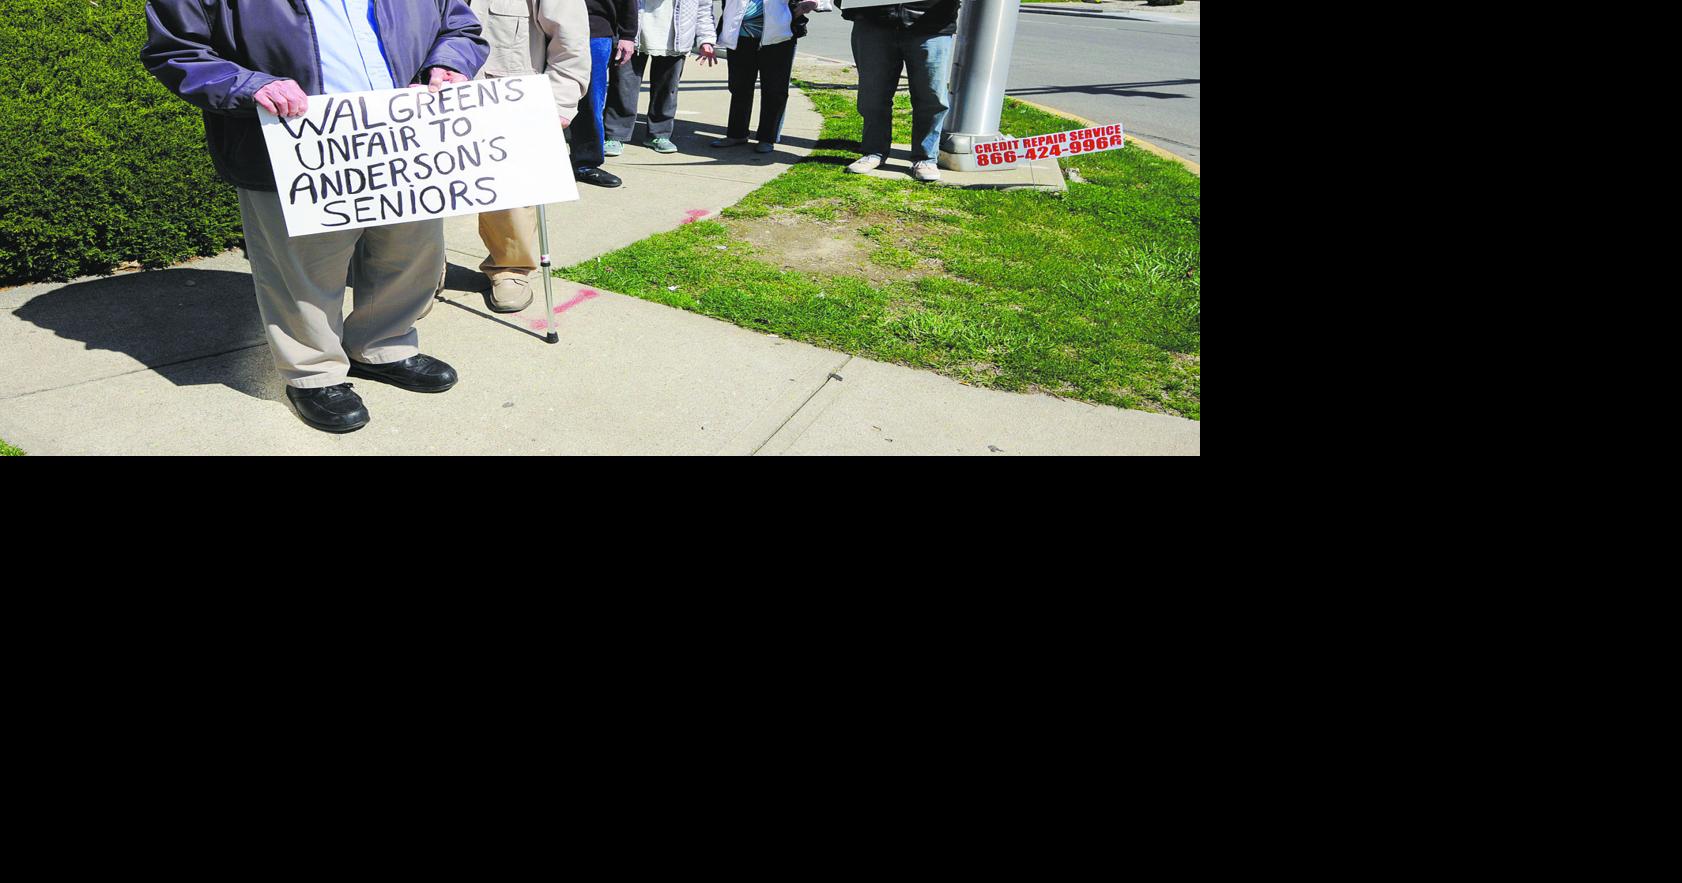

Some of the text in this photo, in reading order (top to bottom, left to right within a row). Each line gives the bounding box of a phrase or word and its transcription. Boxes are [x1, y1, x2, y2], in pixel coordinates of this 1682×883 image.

[429, 116, 473, 142] TO
[975, 124, 1121, 154] CREDIT REPAIR SERVICE
[289, 136, 508, 205] ANDERSON'S
